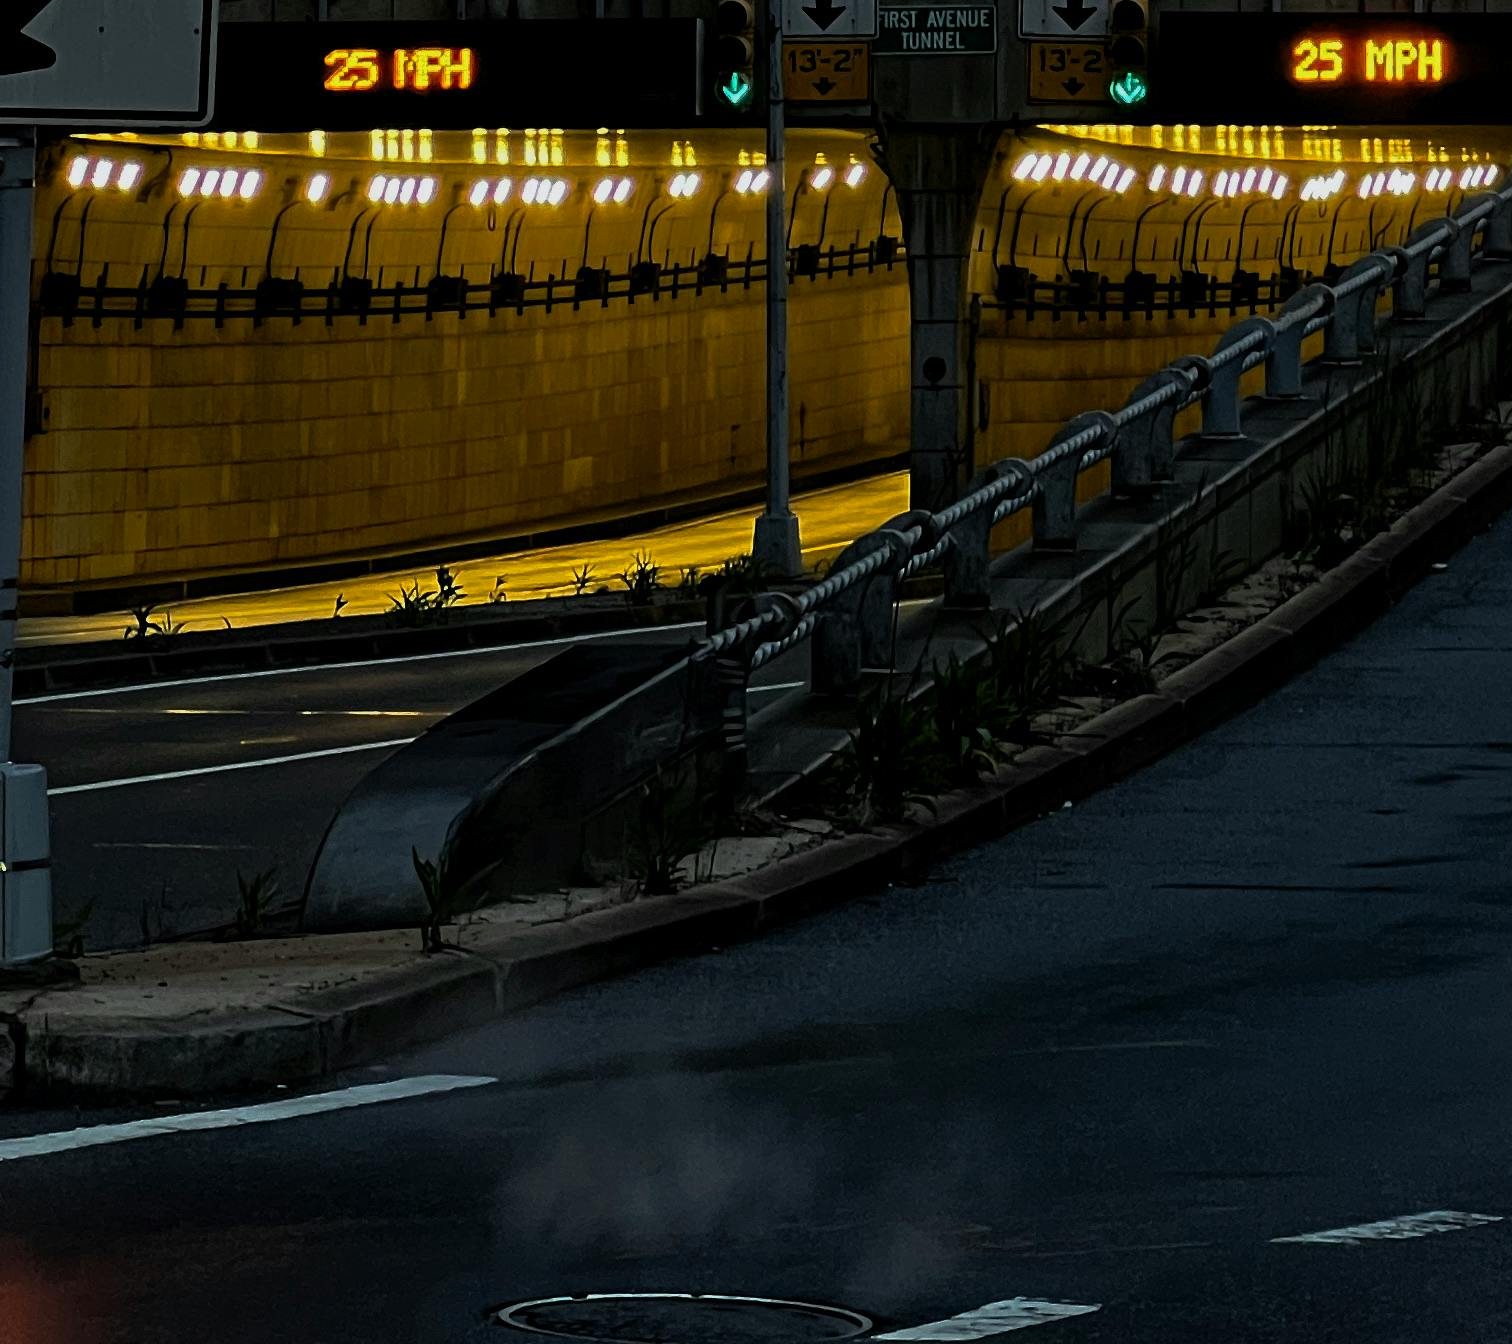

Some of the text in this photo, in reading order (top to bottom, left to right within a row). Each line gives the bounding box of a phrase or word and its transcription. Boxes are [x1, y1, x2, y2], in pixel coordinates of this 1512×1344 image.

[927, 10, 990, 28] AVENUE
[902, 32, 966, 50] TUNNEL
[323, 47, 472, 90] 25 MPH
[1040, 48, 1103, 73] 13'-2
[1294, 39, 1443, 81] 25 MPH
